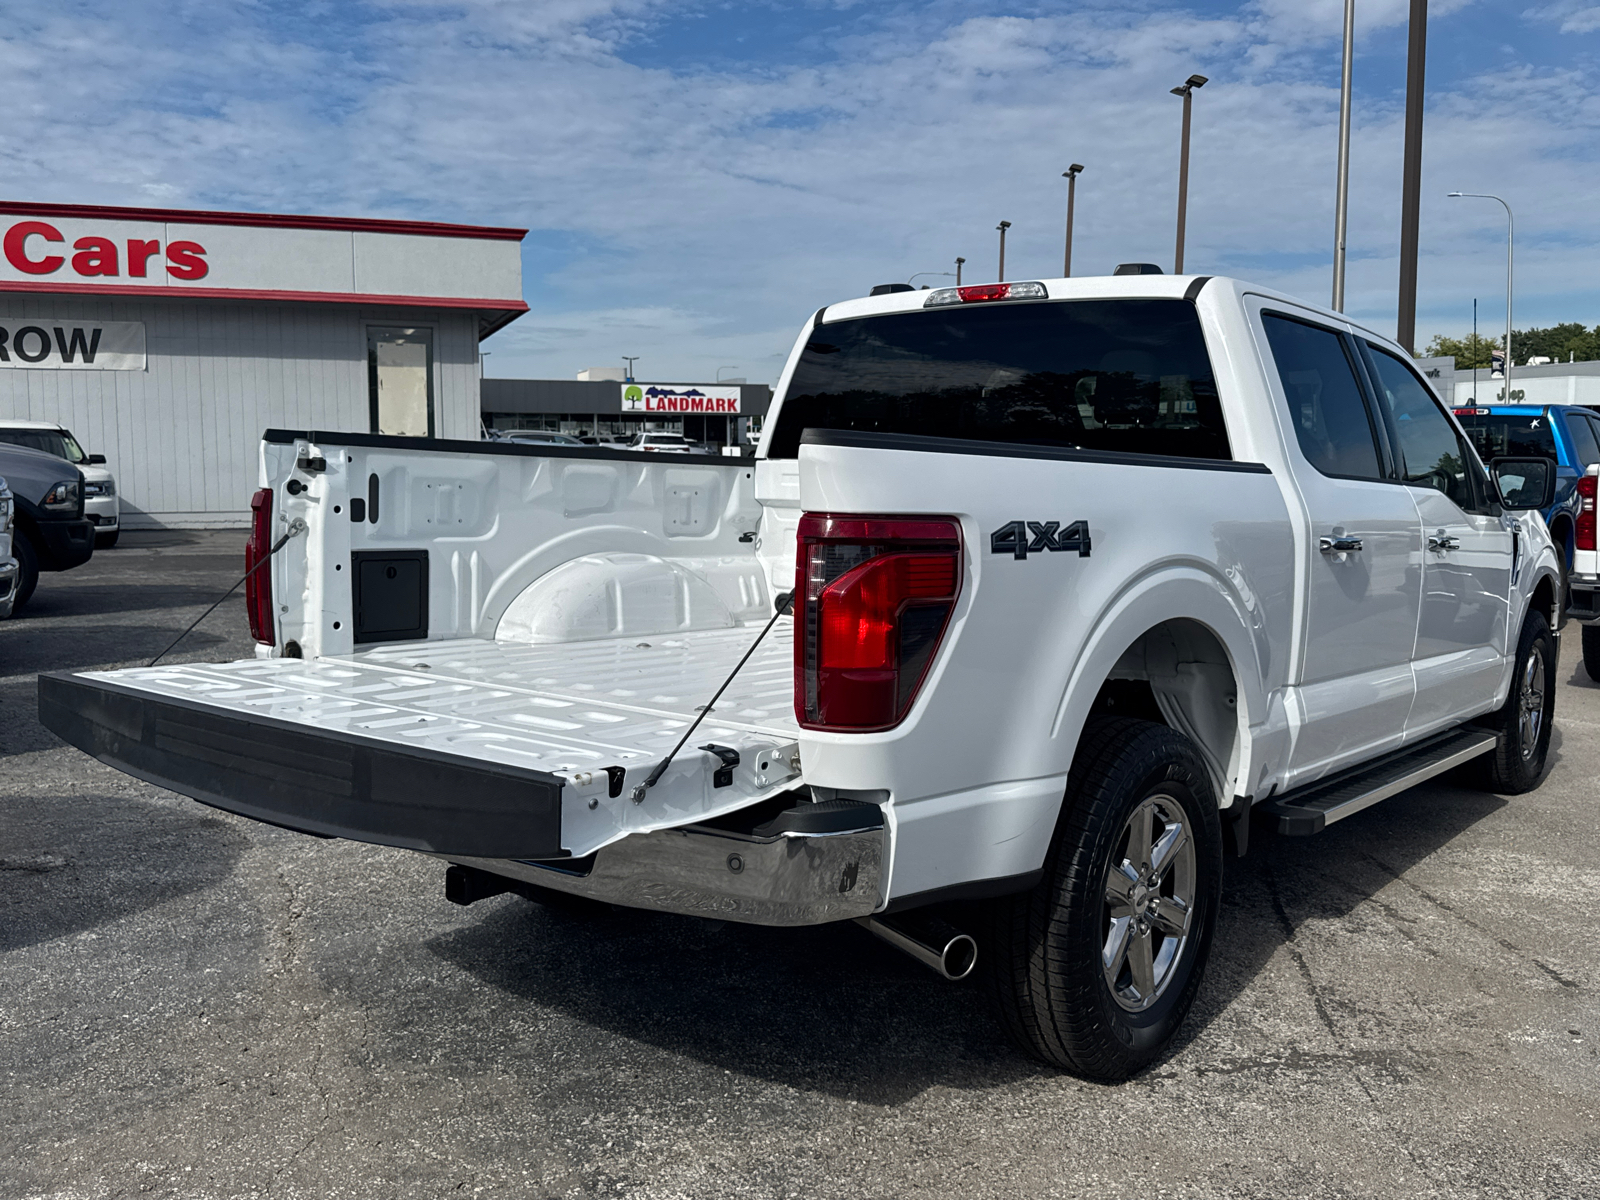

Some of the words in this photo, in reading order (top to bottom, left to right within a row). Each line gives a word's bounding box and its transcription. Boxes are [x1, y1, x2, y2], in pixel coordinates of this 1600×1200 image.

[3, 220, 209, 281] Cars
[1496, 387, 1525, 402] Jep
[645, 396, 738, 413] LANDMARK
